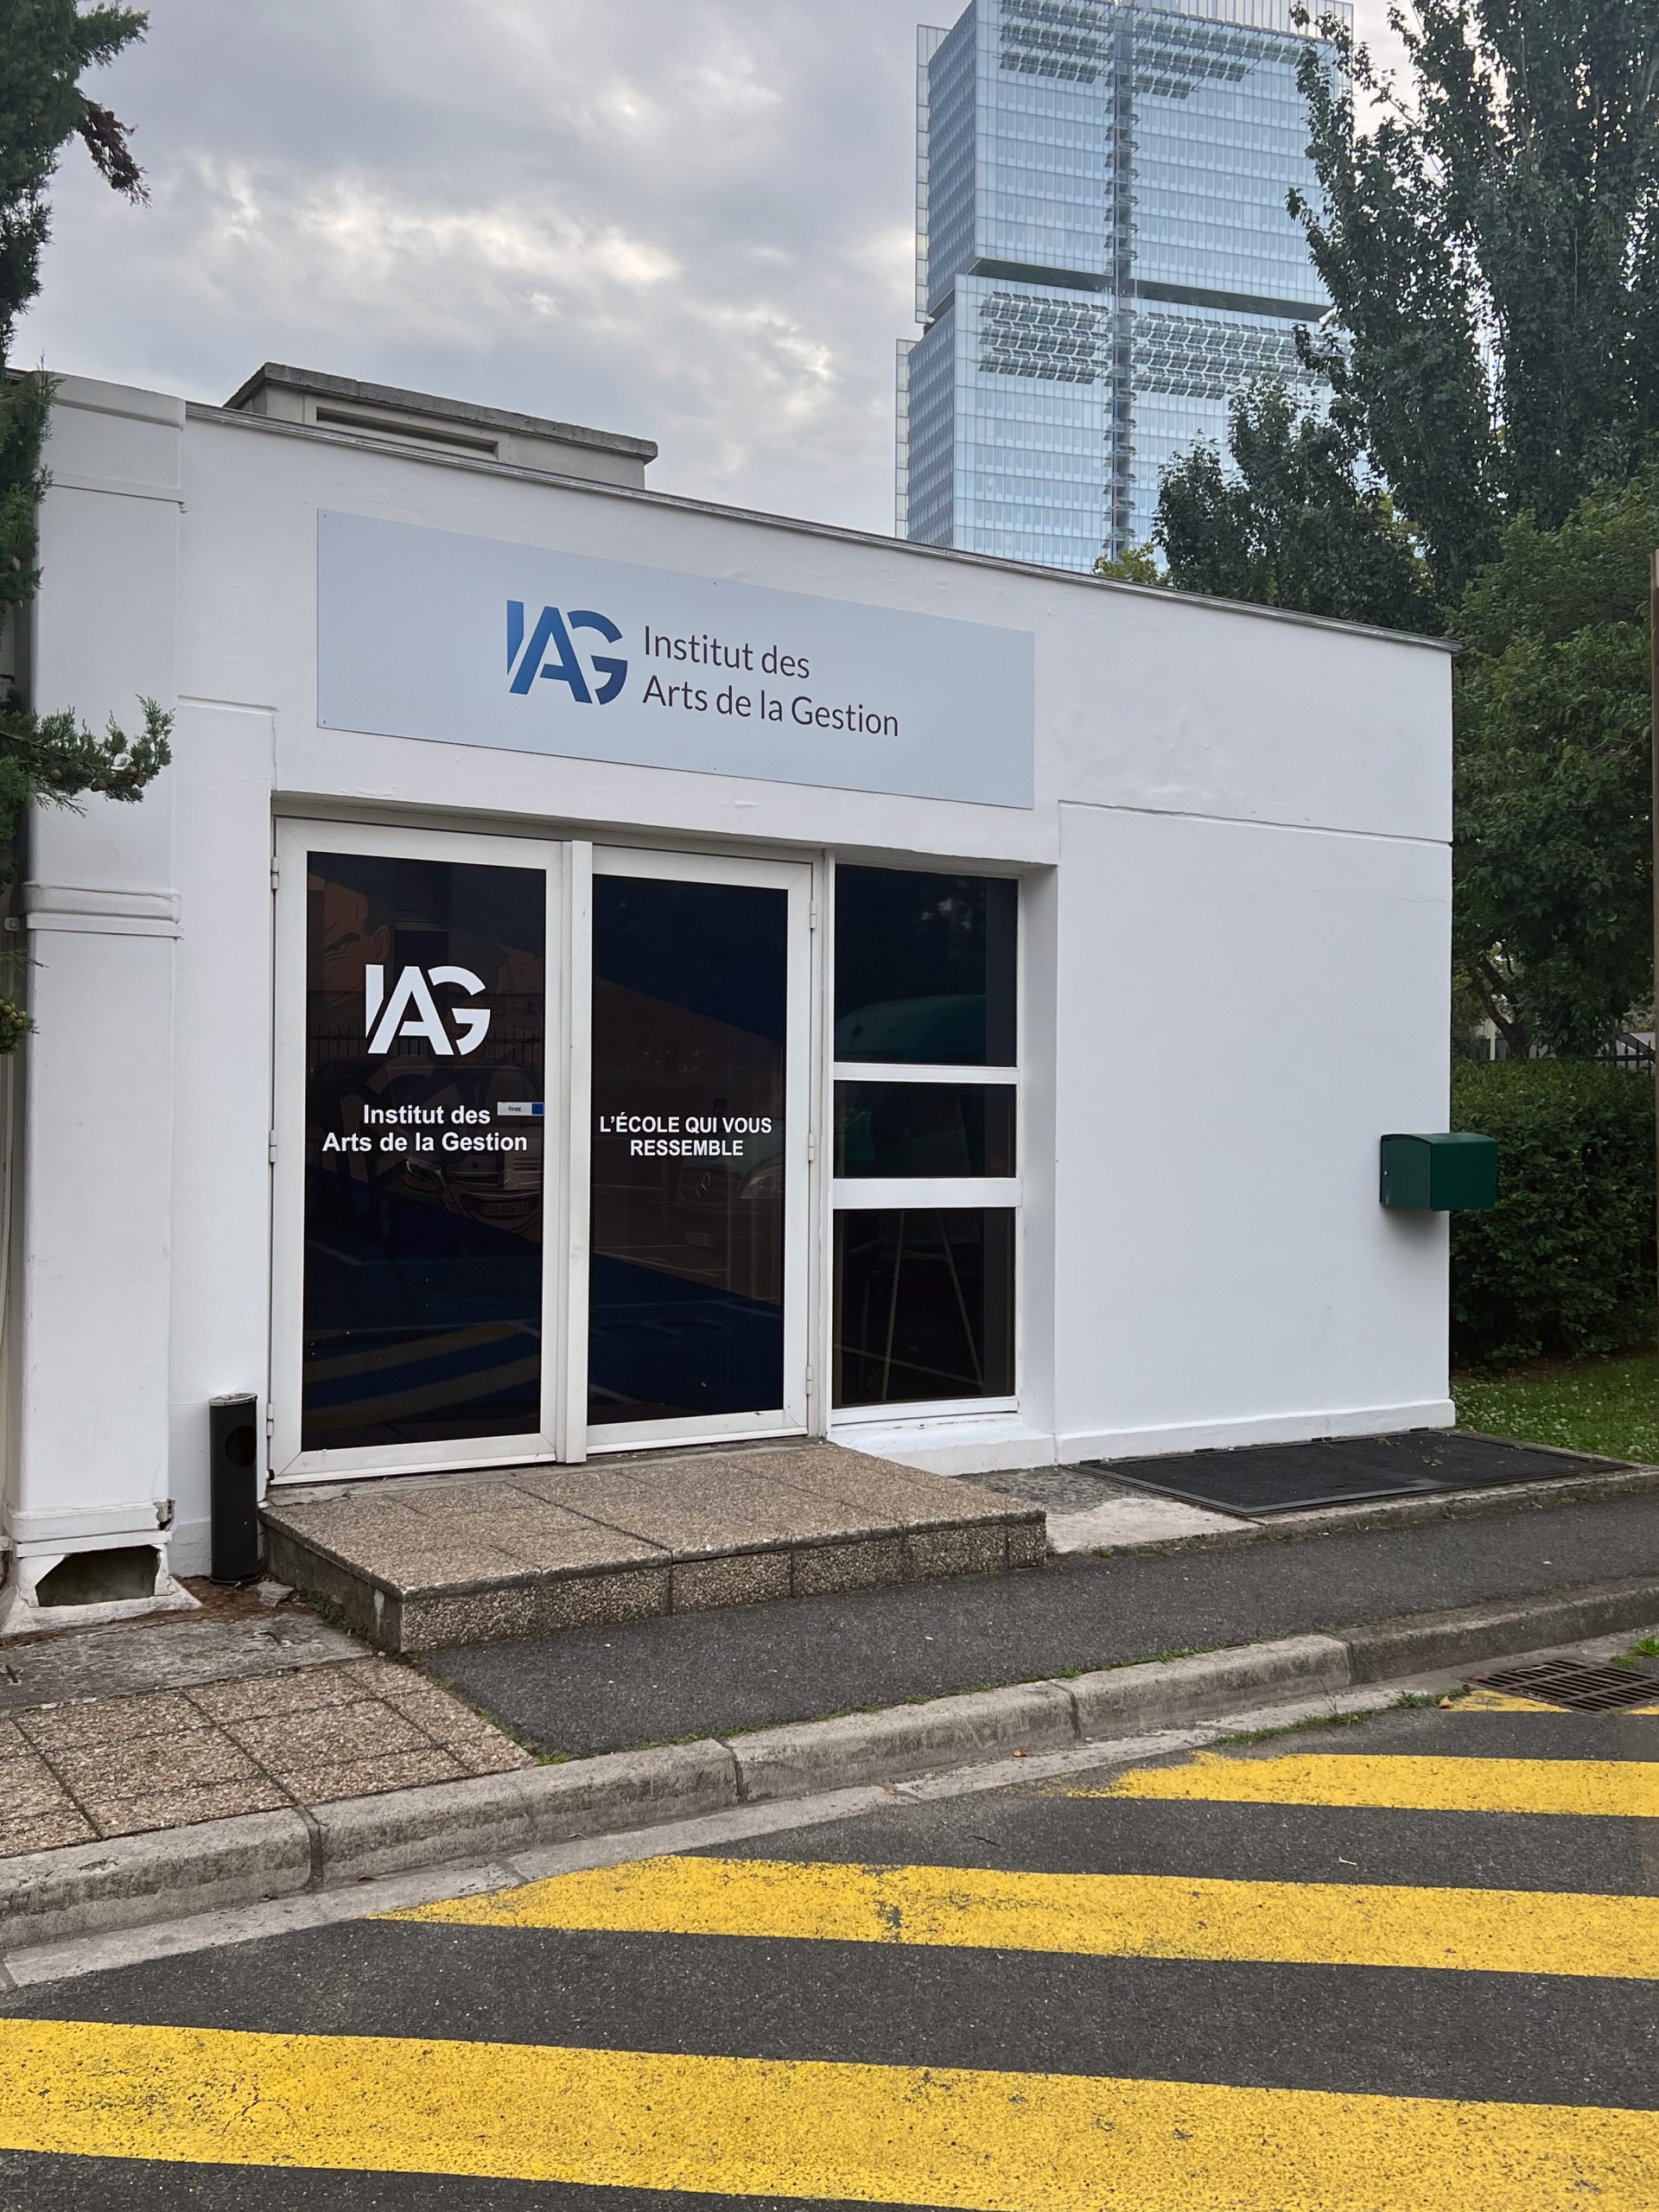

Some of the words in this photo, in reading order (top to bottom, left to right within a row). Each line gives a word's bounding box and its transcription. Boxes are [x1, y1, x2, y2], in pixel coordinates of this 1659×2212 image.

[506, 600, 628, 706] IAG
[645, 625, 753, 671] Institut
[761, 645, 810, 679] des
[642, 674, 708, 711] Arts
[716, 685, 752, 717] de
[760, 690, 783, 722] la
[791, 696, 899, 736] Gestion
[365, 963, 491, 1056] IAG
[364, 1104, 444, 1124] Institut
[451, 1105, 491, 1124] des
[600, 1112, 680, 1133] L’ÉCOLE
[685, 1116, 717, 1134] QUI
[722, 1117, 772, 1134] VOUS
[321, 1132, 372, 1152] Arts
[379, 1132, 408, 1152] de
[415, 1132, 434, 1152] la
[442, 1132, 527, 1152] Gestion
[630, 1140, 744, 1156] RESSEMBLE
